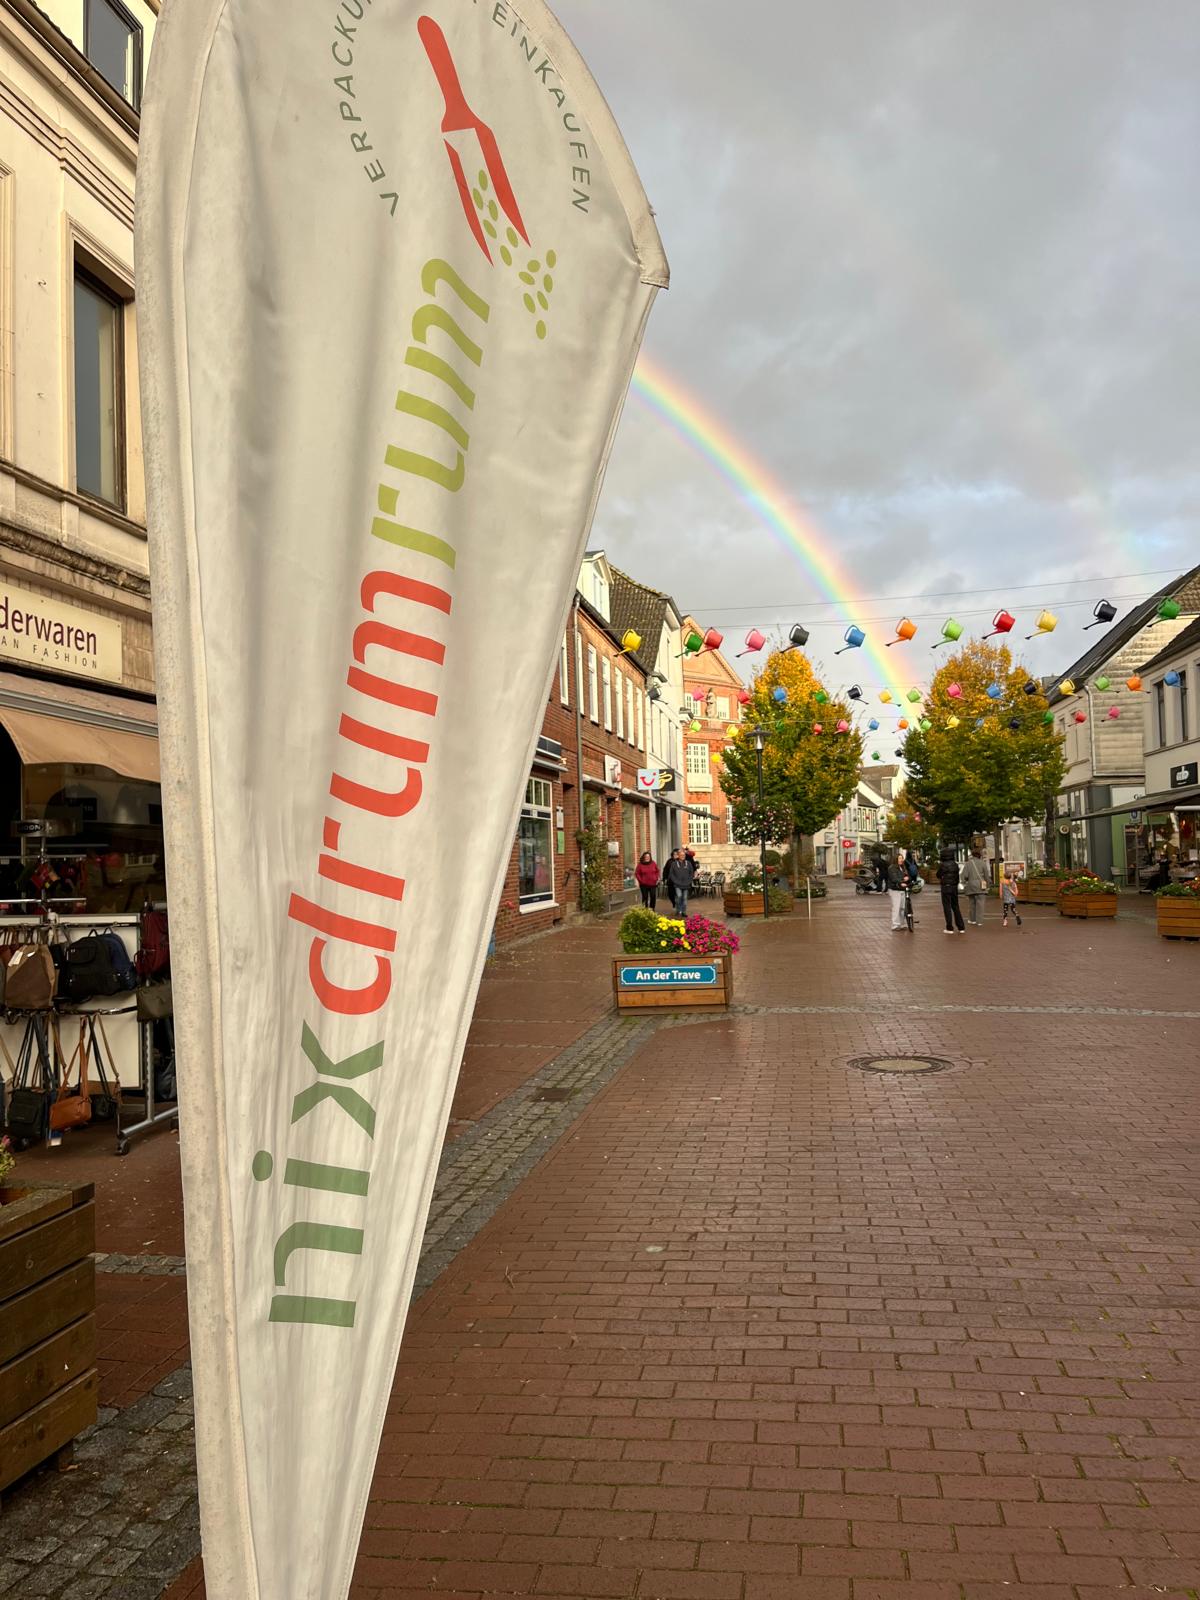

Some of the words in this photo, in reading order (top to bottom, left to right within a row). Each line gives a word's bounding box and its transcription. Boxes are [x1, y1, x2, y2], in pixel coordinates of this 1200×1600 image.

[332, 0, 399, 217] VERPACKU
[492, 2, 591, 213] EINKAUFEN
[33, 644, 97, 669] FASHION
[636, 971, 651, 980] An
[652, 970, 670, 980] der
[671, 970, 701, 980] Trave
